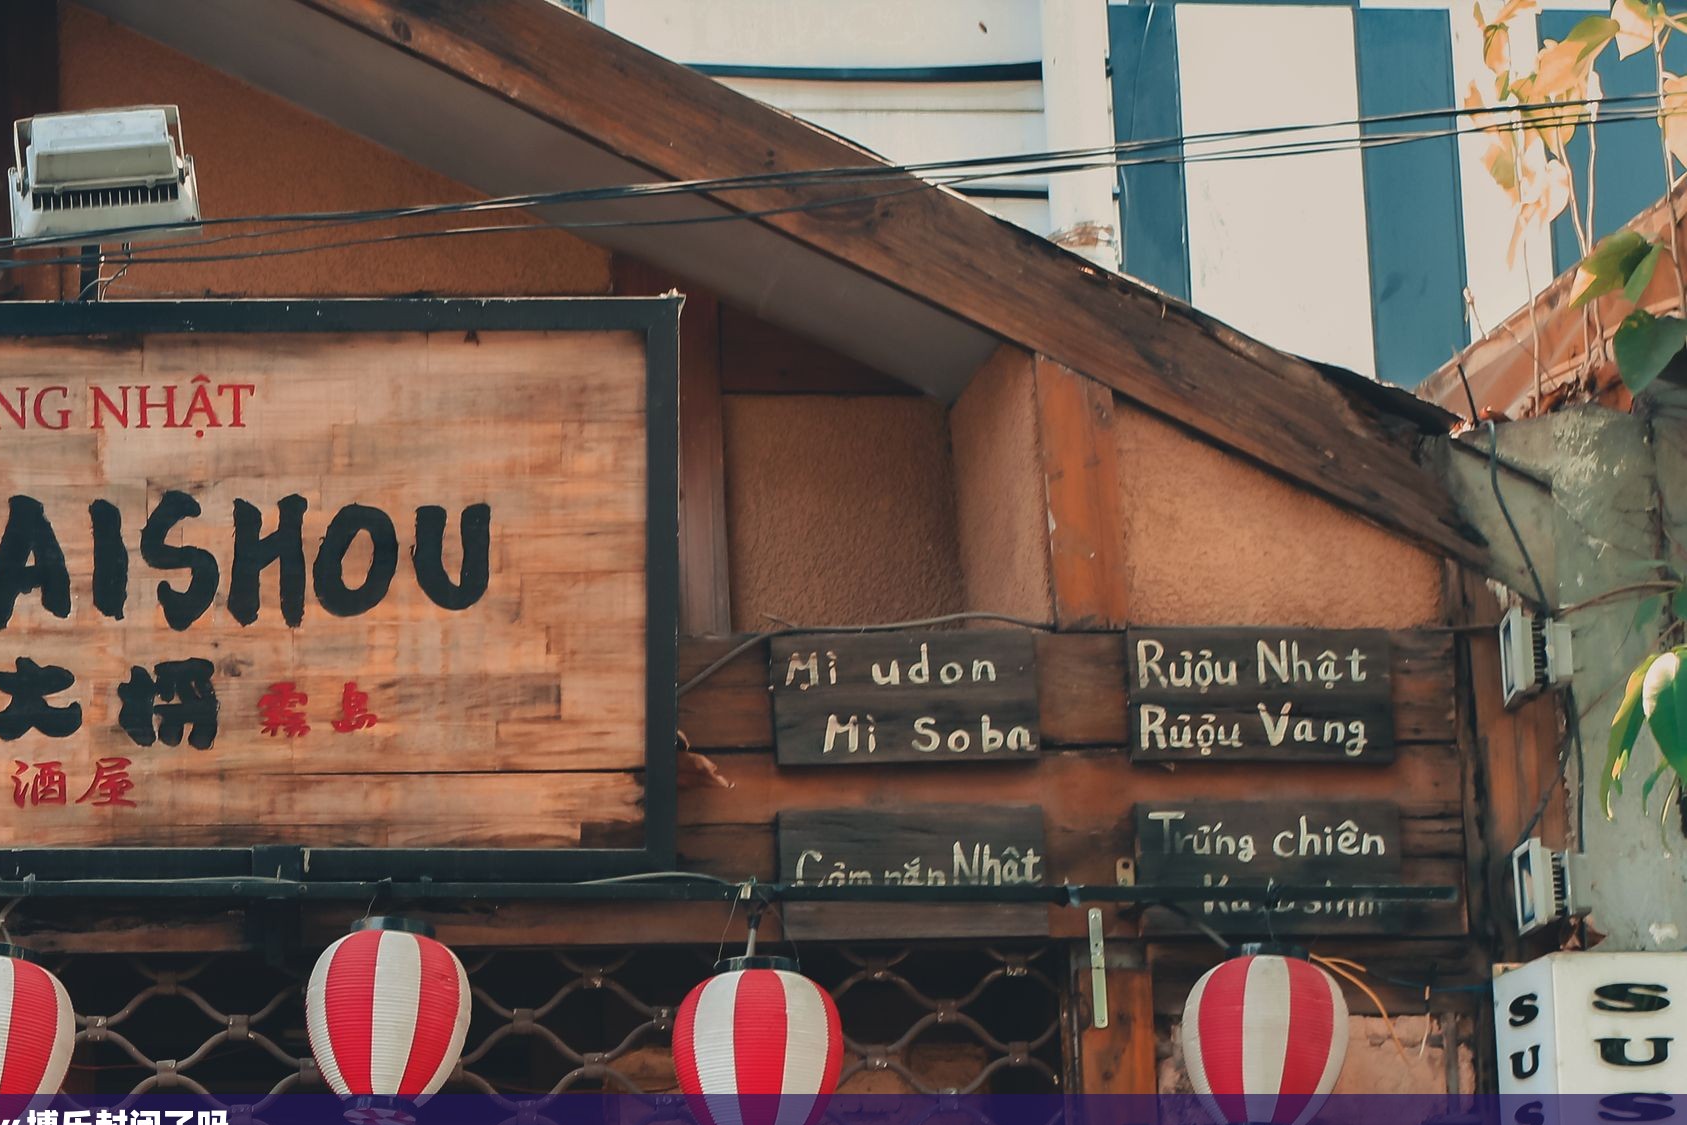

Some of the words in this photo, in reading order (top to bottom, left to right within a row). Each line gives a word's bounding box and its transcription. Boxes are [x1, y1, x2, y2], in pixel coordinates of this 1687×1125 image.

[90, 374, 255, 440] NHẬT
[871, 642, 997, 686] udon
[1256, 639, 1367, 690] Nhật
[1256, 701, 1368, 757] Vang
[1272, 815, 1386, 857] chiên
